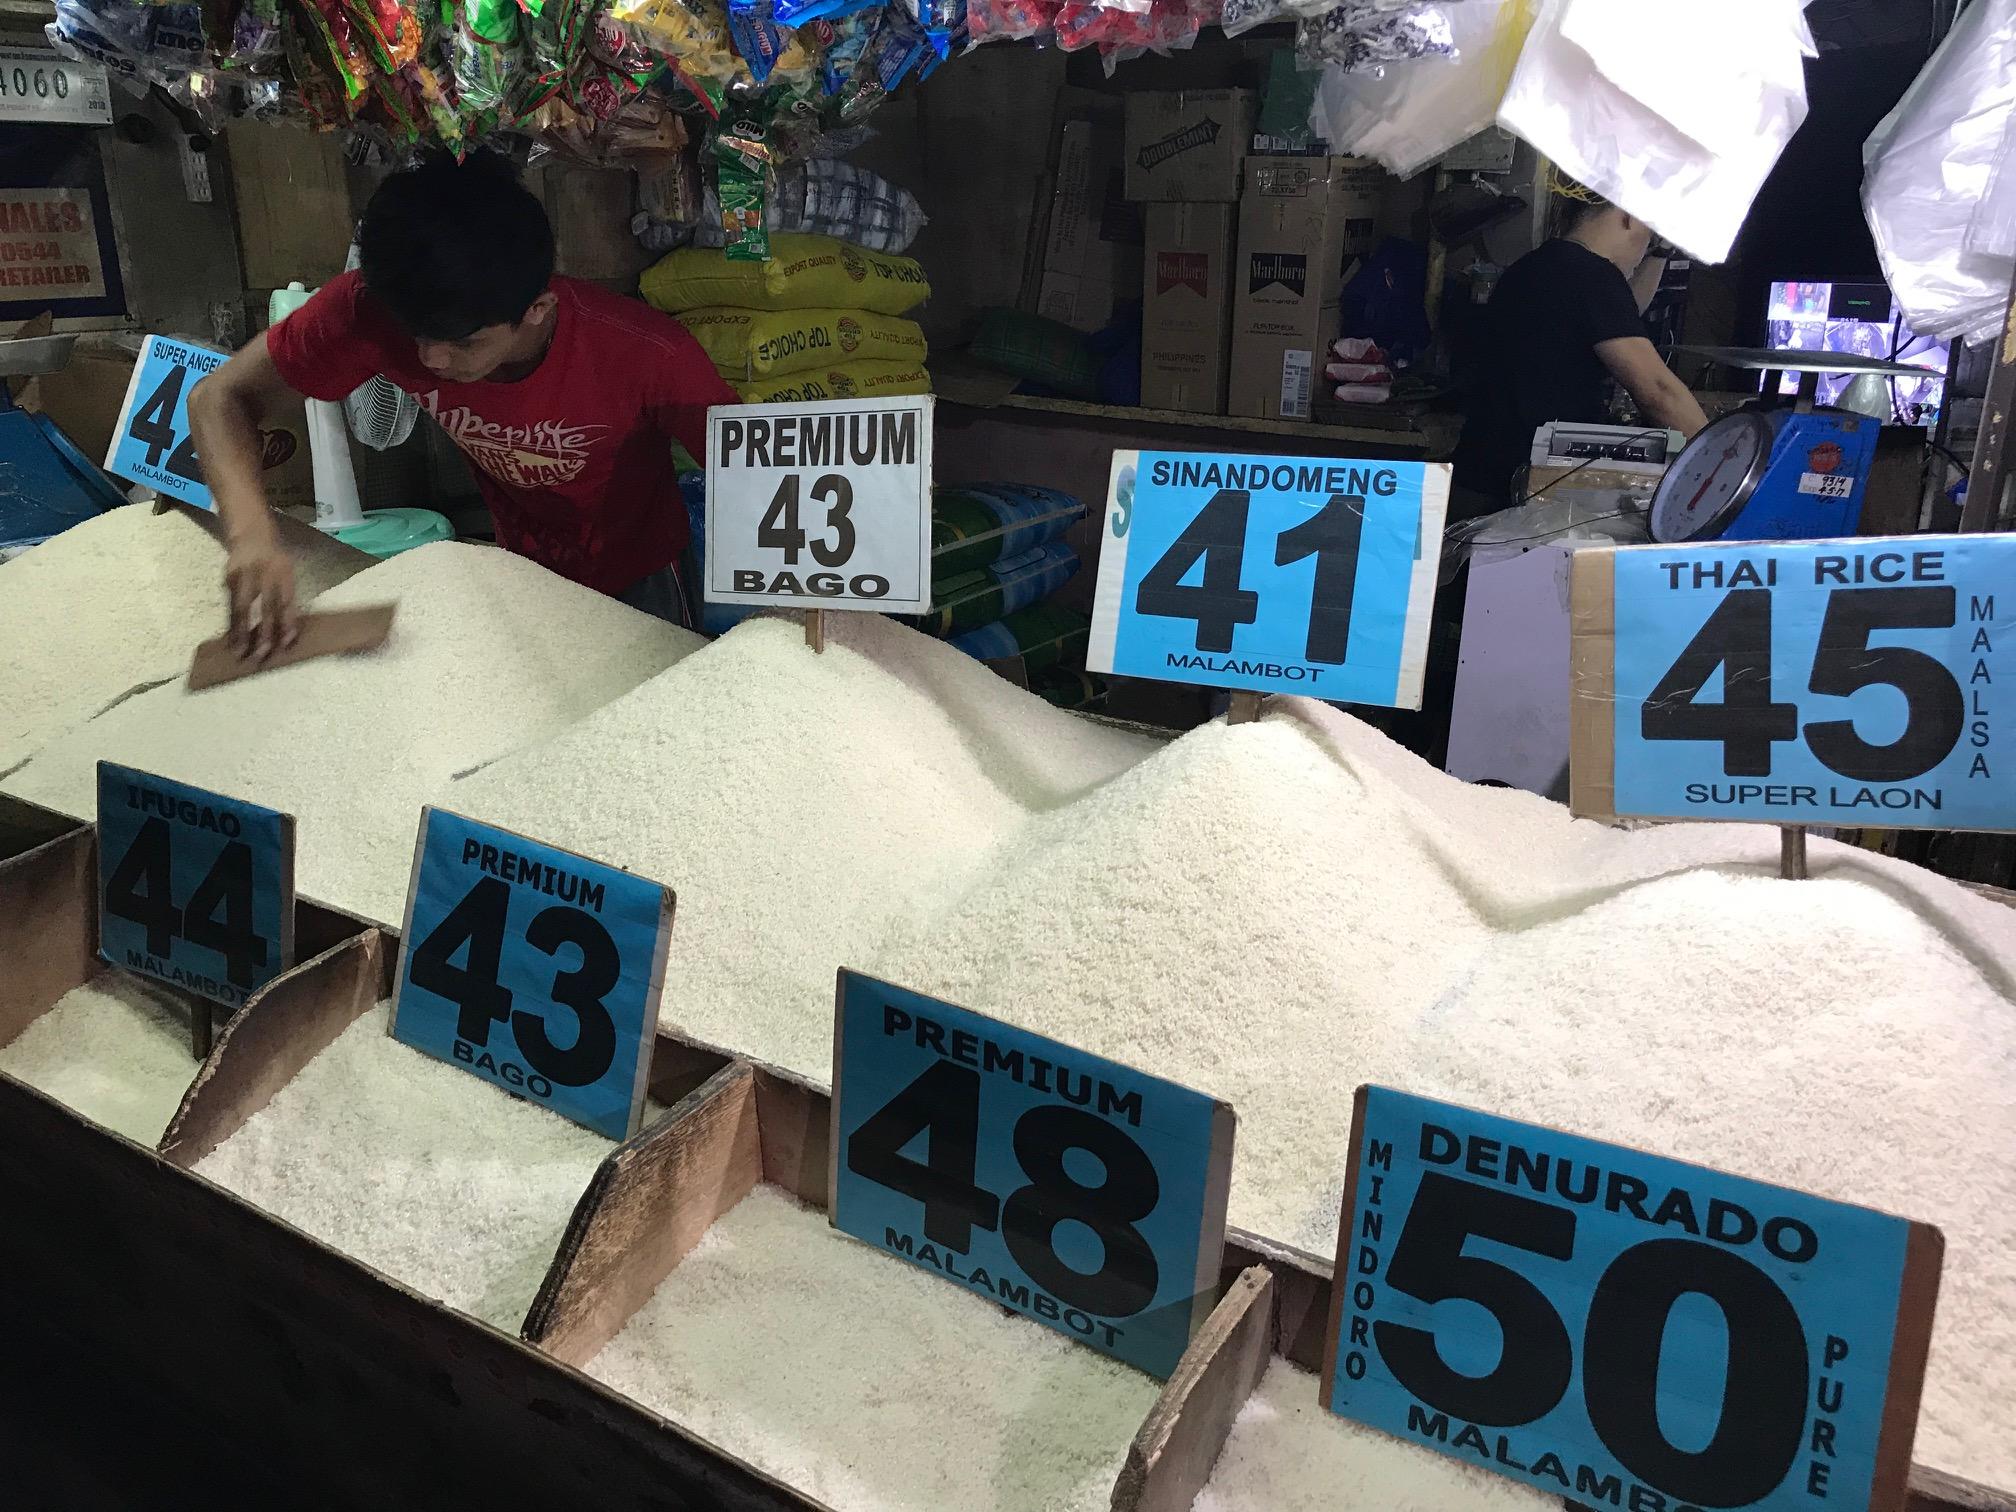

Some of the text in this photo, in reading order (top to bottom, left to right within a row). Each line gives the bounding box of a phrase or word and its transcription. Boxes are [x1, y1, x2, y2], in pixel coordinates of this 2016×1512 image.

[1140, 121, 1215, 166] DOUBLEMINT
[784, 260, 807, 277] EXPORT
[1158, 256, 1208, 281] Marlboro
[1252, 255, 1305, 281] Marlboro
[153, 341, 187, 366] SUPER
[758, 326, 832, 361] TOP CHOICE
[720, 412, 915, 468] PREMIUM
[131, 462, 190, 491] MALAMBOT
[1151, 460, 1398, 496] SINANDOMENG
[758, 473, 856, 568] 43
[733, 569, 890, 598] BAGO
[1135, 488, 1366, 666] 41
[1660, 551, 1946, 590] THAI RICE
[1166, 653, 1325, 683] MALAMBOT
[1641, 585, 1965, 783] 45
[1968, 594, 1995, 779] MAALSA
[127, 785, 241, 837] IFUGAO
[1684, 783, 1943, 811] SUPER LAON
[106, 815, 268, 989] 44
[462, 838, 606, 913] PREMIUM
[409, 875, 621, 1088] 43
[453, 1039, 553, 1098] BAGO
[884, 1004, 1144, 1128] PREMIUM
[848, 1058, 1160, 1318] 48
[1419, 1122, 1819, 1263] DENURADO
[885, 1226, 1125, 1348] MALAMBOT
[1345, 1138, 1393, 1380] MINDORO
[1373, 1170, 1810, 1509] 50
[1806, 1333, 1850, 1499] PURE
